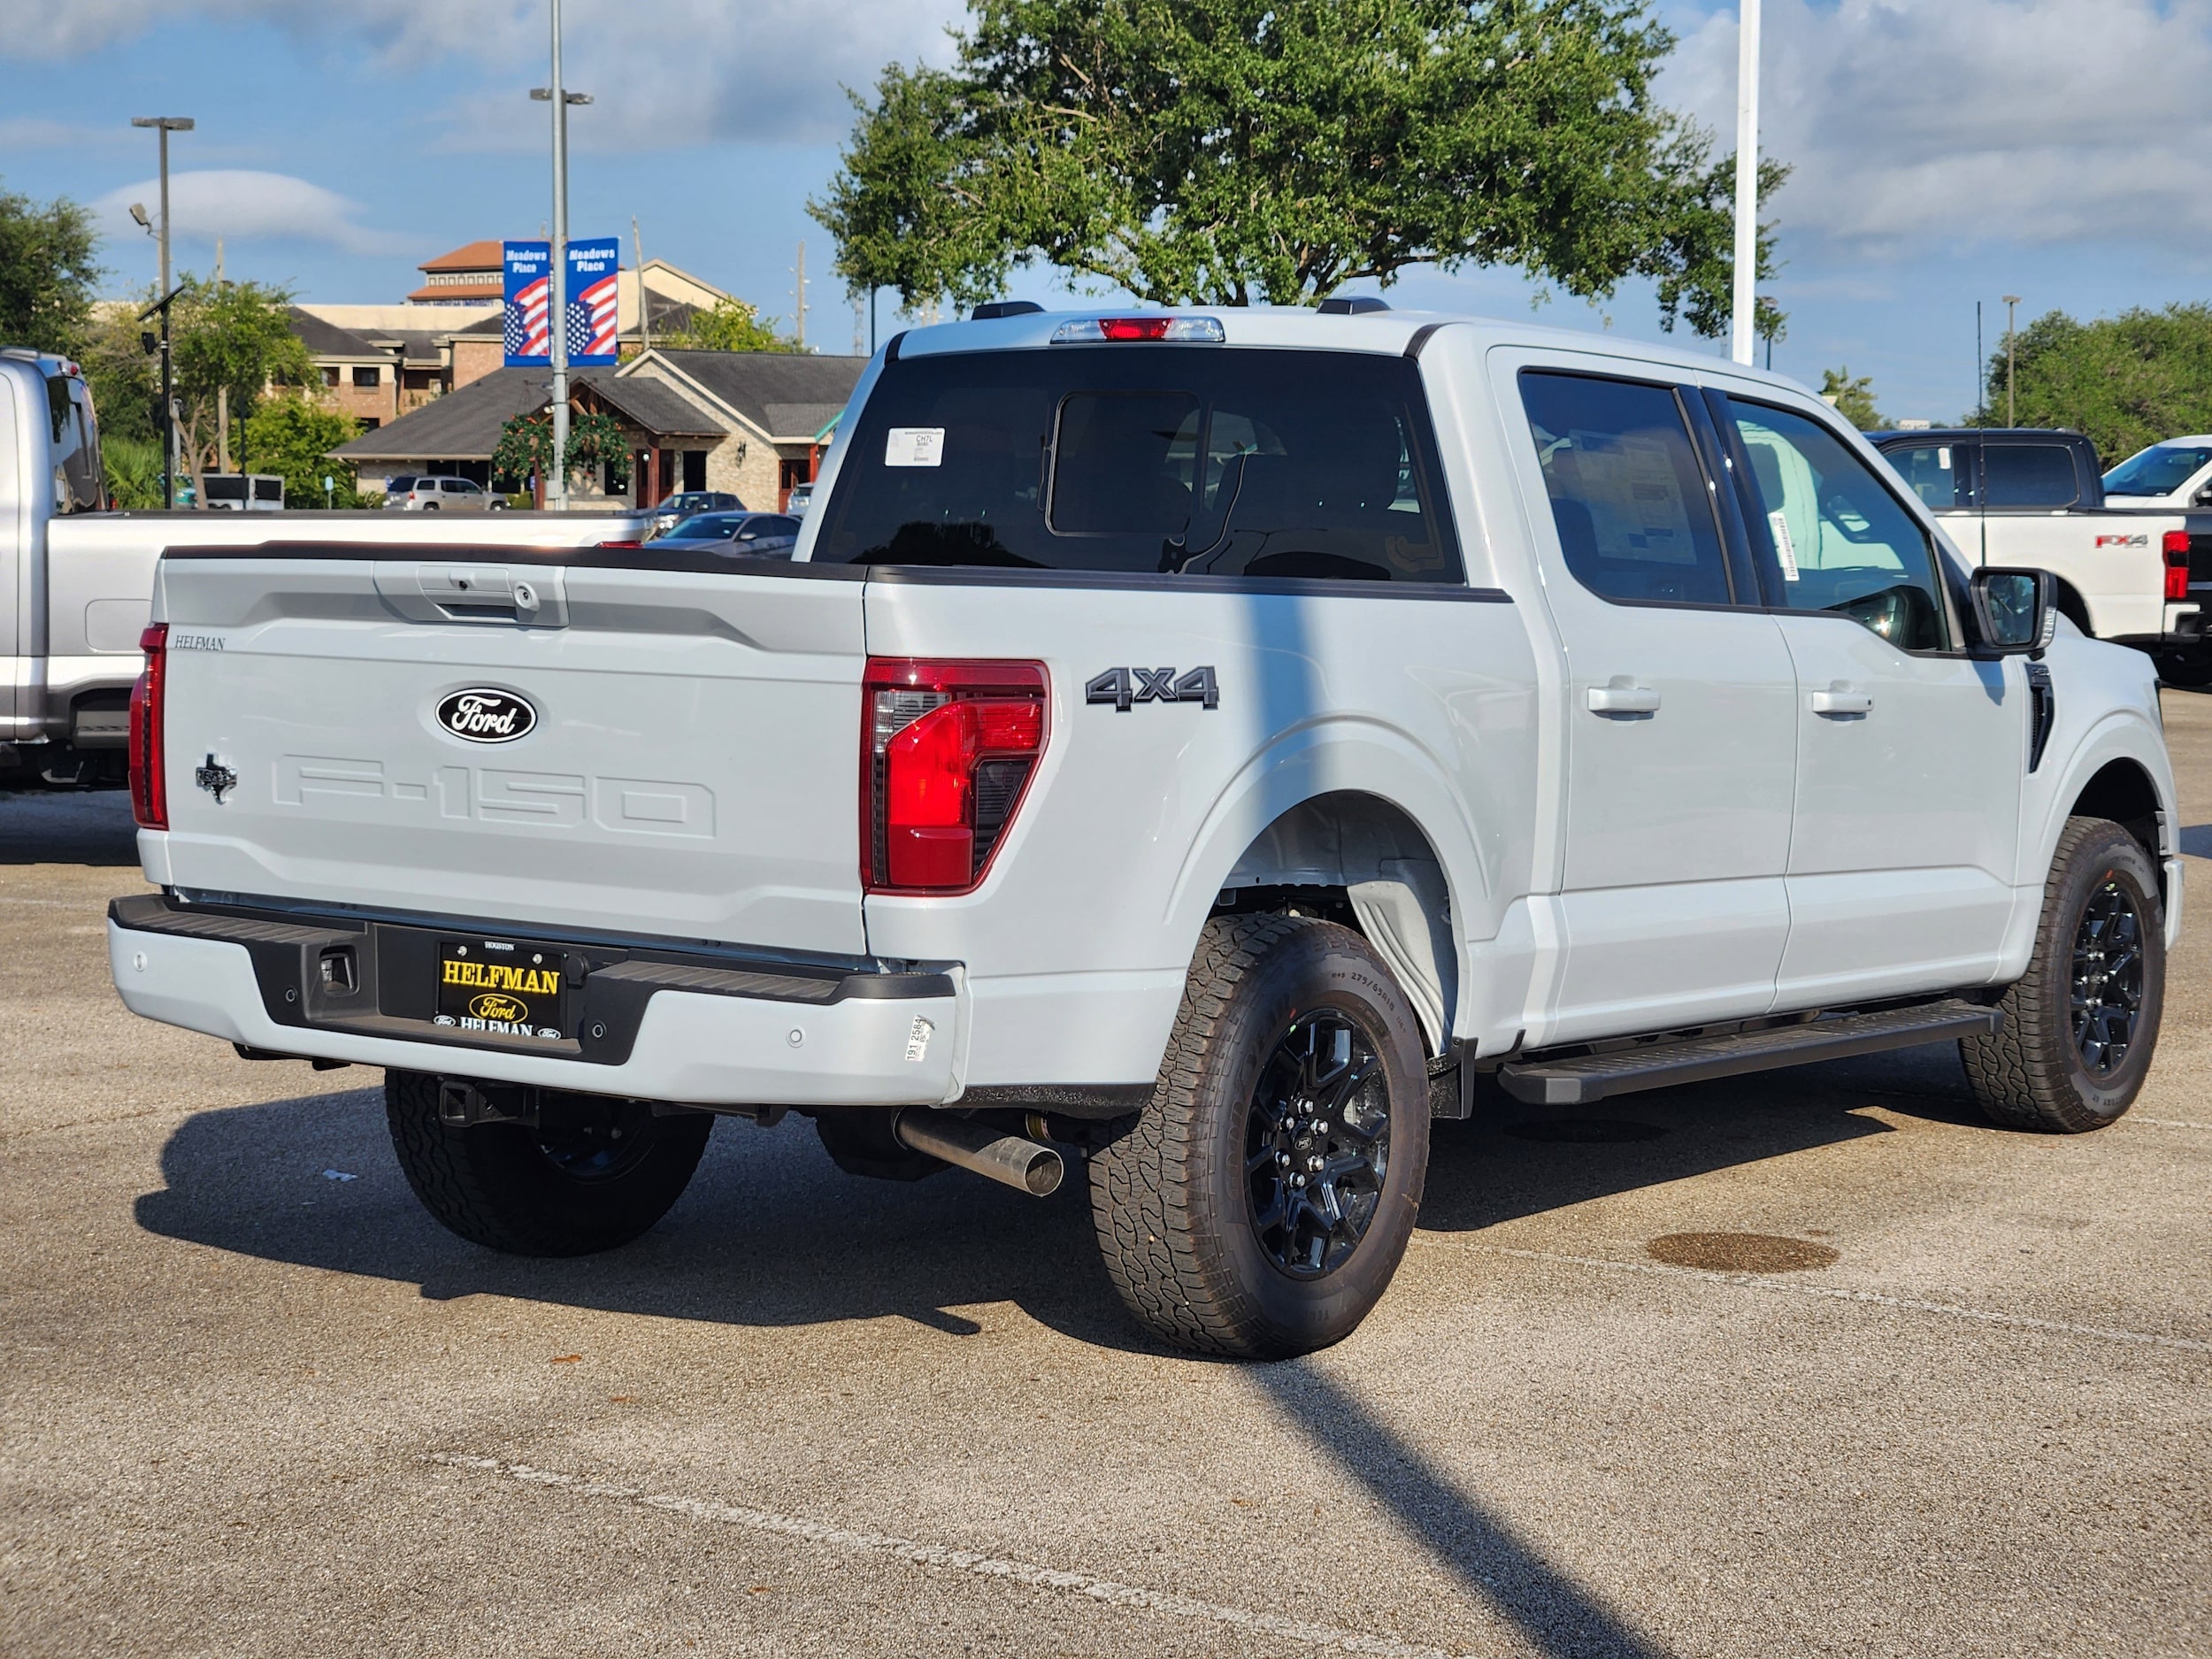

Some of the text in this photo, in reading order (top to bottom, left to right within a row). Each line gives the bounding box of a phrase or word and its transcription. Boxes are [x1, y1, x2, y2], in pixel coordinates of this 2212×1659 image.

[505, 250, 548, 261] Meadows
[568, 248, 615, 261] Meadows
[512, 262, 537, 273] Place
[577, 261, 605, 273] Place
[2095, 534, 2148, 549] FX4
[175, 635, 226, 650] HELFMAN
[451, 695, 518, 733] Ford
[272, 753, 718, 840] F-150
[484, 941, 516, 951] HOUSTON
[442, 960, 561, 995] HELFMAN
[479, 996, 517, 1020] Ford
